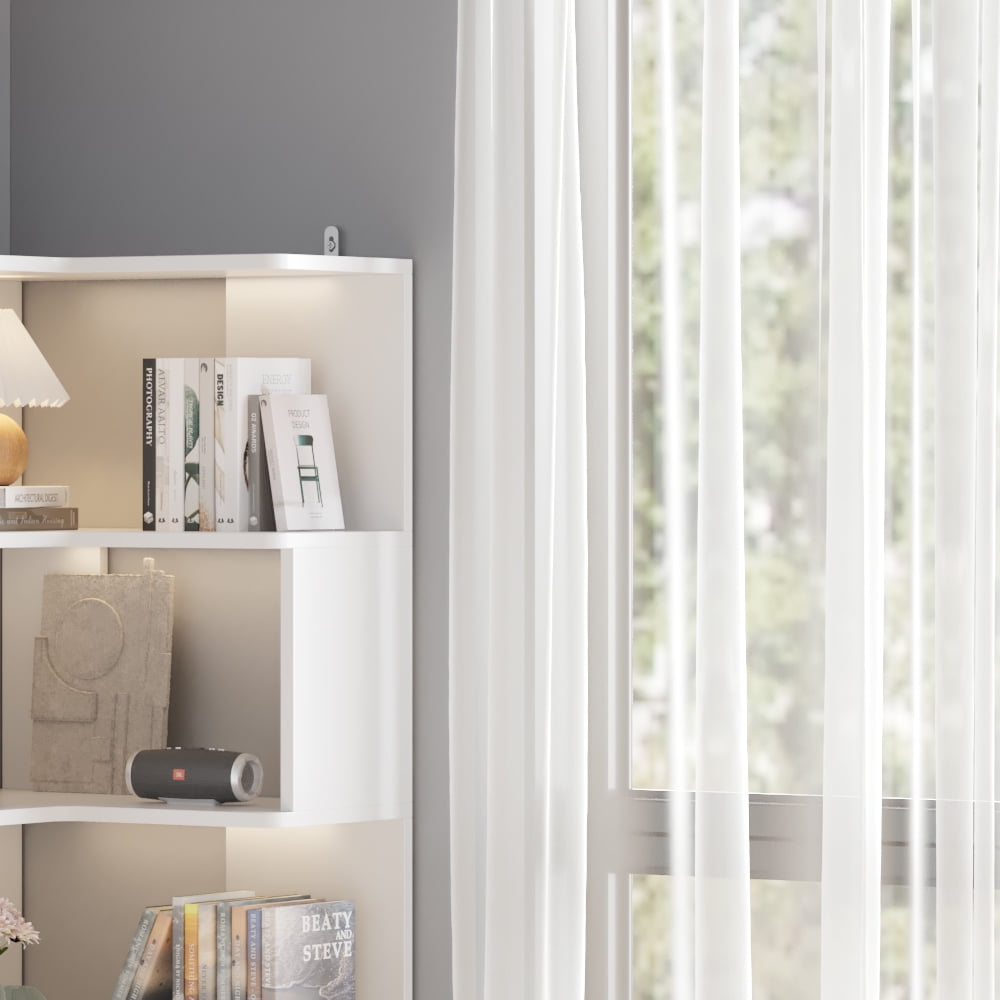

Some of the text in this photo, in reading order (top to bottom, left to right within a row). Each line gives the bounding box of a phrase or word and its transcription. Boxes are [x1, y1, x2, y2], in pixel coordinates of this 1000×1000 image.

[216, 373, 224, 406] DESIGN
[145, 367, 153, 446] PHOTOGRAPHY
[157, 407, 166, 445] AALTO
[249, 913, 257, 939] BEATY
[302, 910, 353, 933] BEATY
[335, 929, 353, 941] AND
[249, 942, 257, 960] AND
[264, 943, 272, 961] AND
[303, 940, 353, 962] STEVE
[249, 961, 257, 986] STEVE
